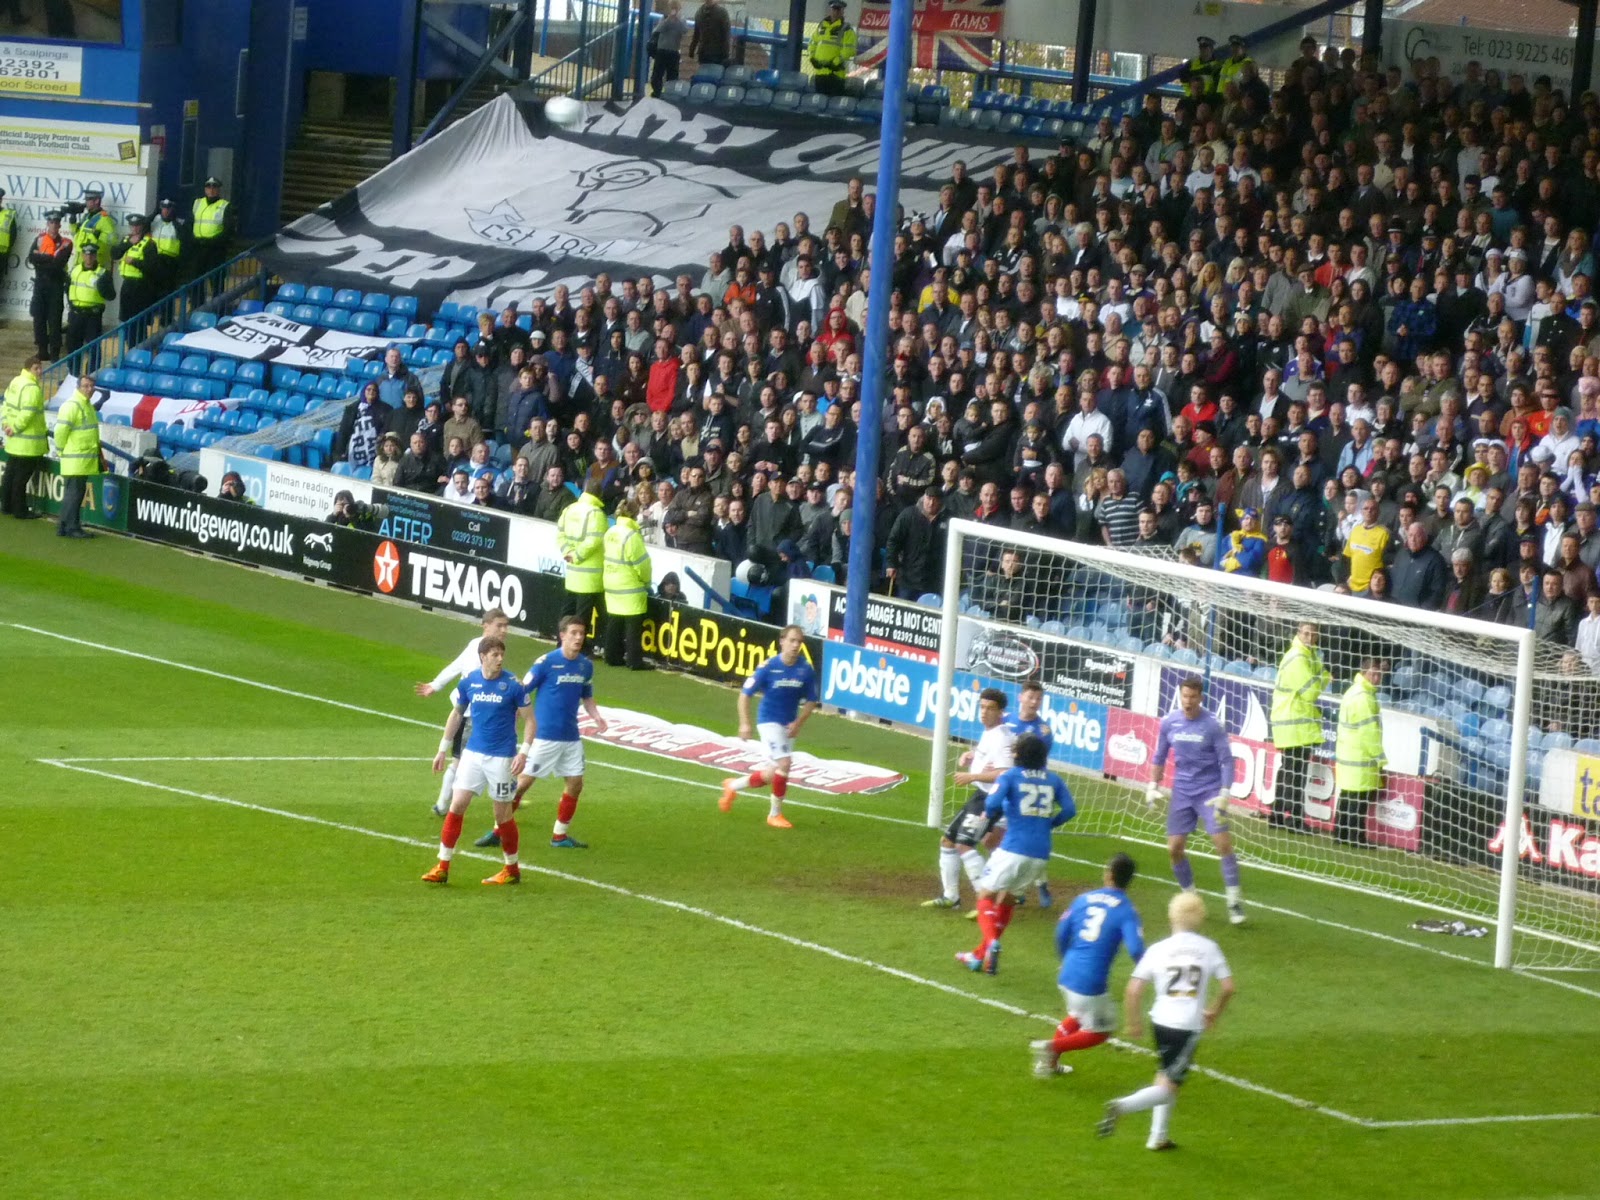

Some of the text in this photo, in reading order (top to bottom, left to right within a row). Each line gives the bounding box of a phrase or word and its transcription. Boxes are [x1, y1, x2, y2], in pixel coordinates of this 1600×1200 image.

[862, 12, 990, 30] SWIN RAMS
[15, 47, 69, 59] Scalpings
[24, 81, 68, 92] Screed
[24, 131, 51, 142] Supply
[38, 140, 70, 149] Football
[6, 174, 134, 205] WINDOW
[271, 472, 301, 488] holman
[302, 481, 334, 498] reading
[269, 488, 330, 510] partnership llp
[136, 498, 294, 556] www.ridgeway.co.uk
[378, 515, 433, 545] AFTER
[408, 552, 524, 619] TEXACO
[896, 609, 903, 627] &
[903, 611, 922, 631] MOT
[922, 614, 942, 636] CENT
[641, 610, 779, 678] adePoint
[871, 625, 884, 637] and
[892, 629, 913, 643] 02392
[825, 650, 911, 706] jobsite
[472, 691, 503, 704] jobsite
[1076, 688, 1101, 704] Tuning
[1099, 683, 1126, 698] Premier
[496, 782, 509, 797] 15
[1018, 782, 1056, 819] 23
[1079, 905, 1108, 943] 3
